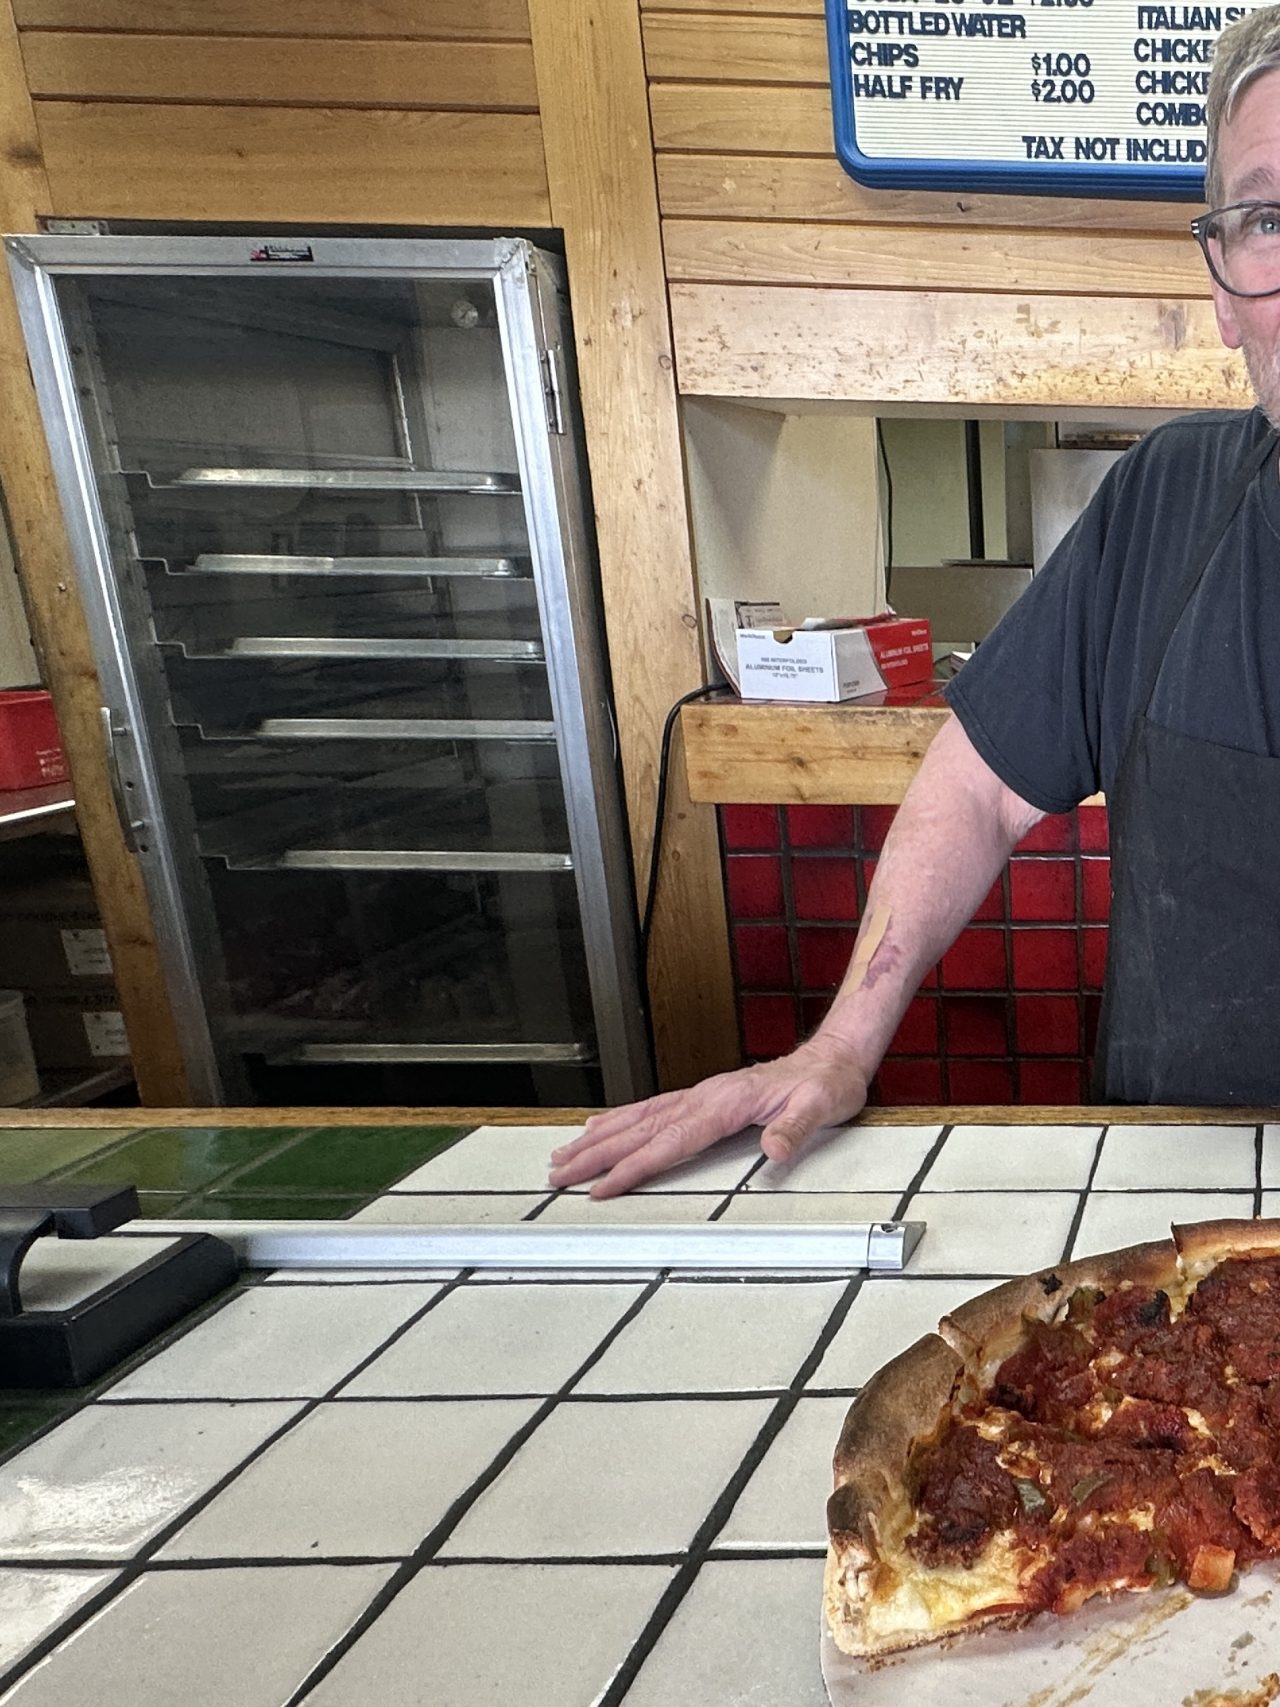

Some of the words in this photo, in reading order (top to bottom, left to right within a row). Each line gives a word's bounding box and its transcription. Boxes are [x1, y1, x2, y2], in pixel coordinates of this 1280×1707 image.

[849, 10, 950, 35] BOTTLED
[951, 12, 1027, 38] WATER
[1137, 5, 1221, 31] ITALIAN
[851, 42, 919, 67] CHIPS
[1133, 38, 1216, 63] CHICKE
[1031, 53, 1091, 77] $1.00
[853, 74, 913, 99] HALF
[919, 76, 964, 100] FRY
[1031, 79, 1095, 104] $2.00
[1135, 70, 1213, 95] CHICK
[1136, 101, 1208, 127] COMB
[1022, 136, 1064, 160] TAX
[1075, 136, 1120, 161] NOT
[1126, 138, 1208, 162] INCLUD
